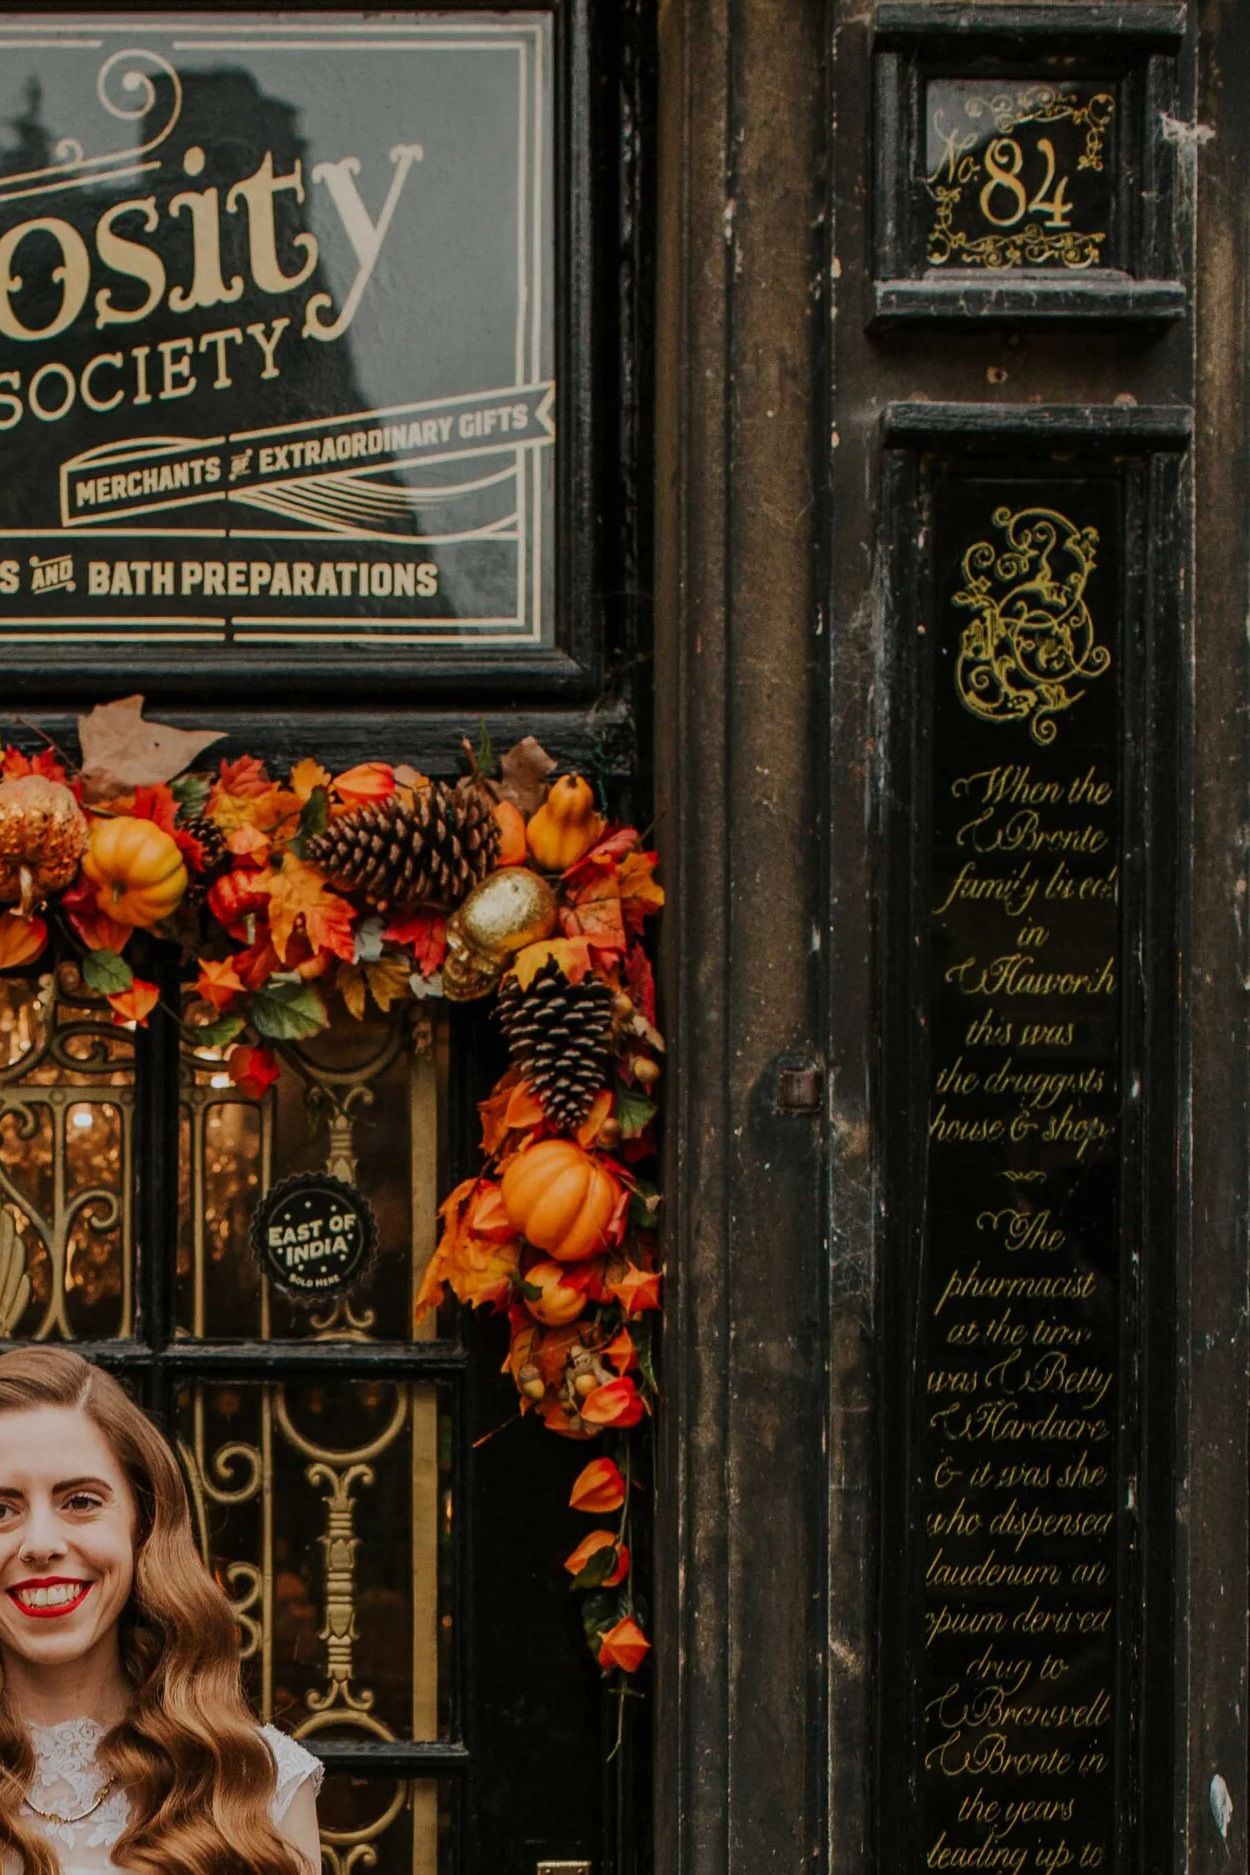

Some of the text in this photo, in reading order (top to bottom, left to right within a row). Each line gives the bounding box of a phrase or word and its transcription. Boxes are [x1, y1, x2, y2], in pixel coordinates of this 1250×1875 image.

[980, 137, 1073, 227] 84
[75, 458, 222, 507] MERCHANTS
[259, 416, 453, 474] EXTRAORDINARY
[459, 404, 529, 439] GIFTS
[31, 558, 75, 591] AND
[89, 561, 174, 597] BATH
[182, 561, 438, 597] PREPARATIONS
[951, 764, 1113, 806] When the
[956, 806, 1109, 853] Bronte
[931, 861, 1039, 917] family
[1017, 916, 1049, 948] in
[965, 1008, 1075, 1046] this was
[935, 1055, 979, 1095] the
[929, 1103, 1109, 1160] house & shop
[268, 1213, 357, 1247] EAST OF
[976, 1208, 1066, 1251] The
[286, 1235, 348, 1267] INDIA
[288, 1273, 341, 1288] SOLD HERE
[934, 1259, 1097, 1316] pharmacist
[947, 1320, 980, 1345] at
[986, 1308, 1028, 1345] the
[927, 1349, 1113, 1410] was Betty
[934, 1450, 1107, 1489] & it was she
[926, 1497, 983, 1536] who
[966, 1643, 1069, 1697] drug to
[924, 1730, 1109, 1776] Bronte in
[958, 1787, 1075, 1838] the years
[1079, 1841, 1104, 1868] to
